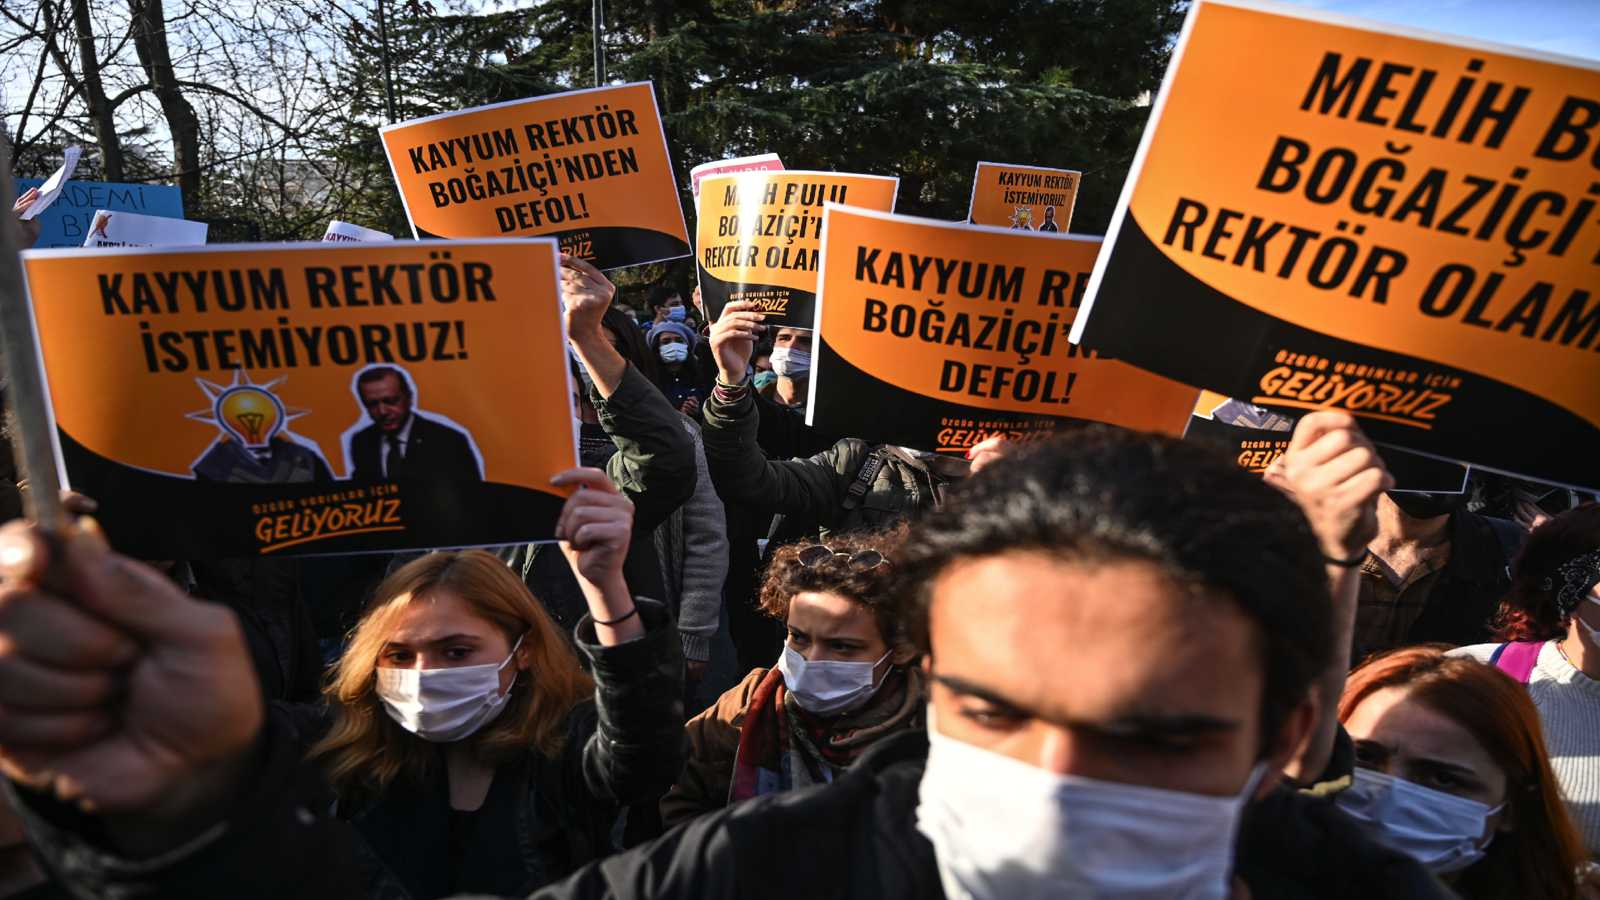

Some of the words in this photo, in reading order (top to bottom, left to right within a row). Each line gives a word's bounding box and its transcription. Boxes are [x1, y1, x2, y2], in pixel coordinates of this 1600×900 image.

[408, 128, 518, 174] KAYYUM
[524, 105, 639, 151] REKTÖR
[1299, 51, 1532, 149] MELİH
[1533, 96, 1600, 170] B
[430, 147, 639, 208] BOĞAZİÇİ'NDEN
[998, 171, 1042, 188] KAYYUM
[1043, 174, 1074, 190] REKTÖR
[1256, 135, 1600, 267] BOĞAZİÇİ
[495, 193, 589, 233] DEFOL!
[98, 265, 289, 316] KAYYUM
[305, 251, 497, 308] REKTÖR
[854, 245, 1026, 302] KAYYUM
[1037, 268, 1093, 308] RE
[1163, 197, 1408, 305] REKTÖR
[1418, 263, 1600, 353] OLAM
[140, 316, 469, 373] İSTEMİYORUZ!
[1275, 350, 1329, 370] ÖZGÜR
[939, 359, 1078, 404] DEFOL!
[1259, 366, 1452, 419] GELİYORUZ
[255, 500, 401, 543] GELİYORUZ
